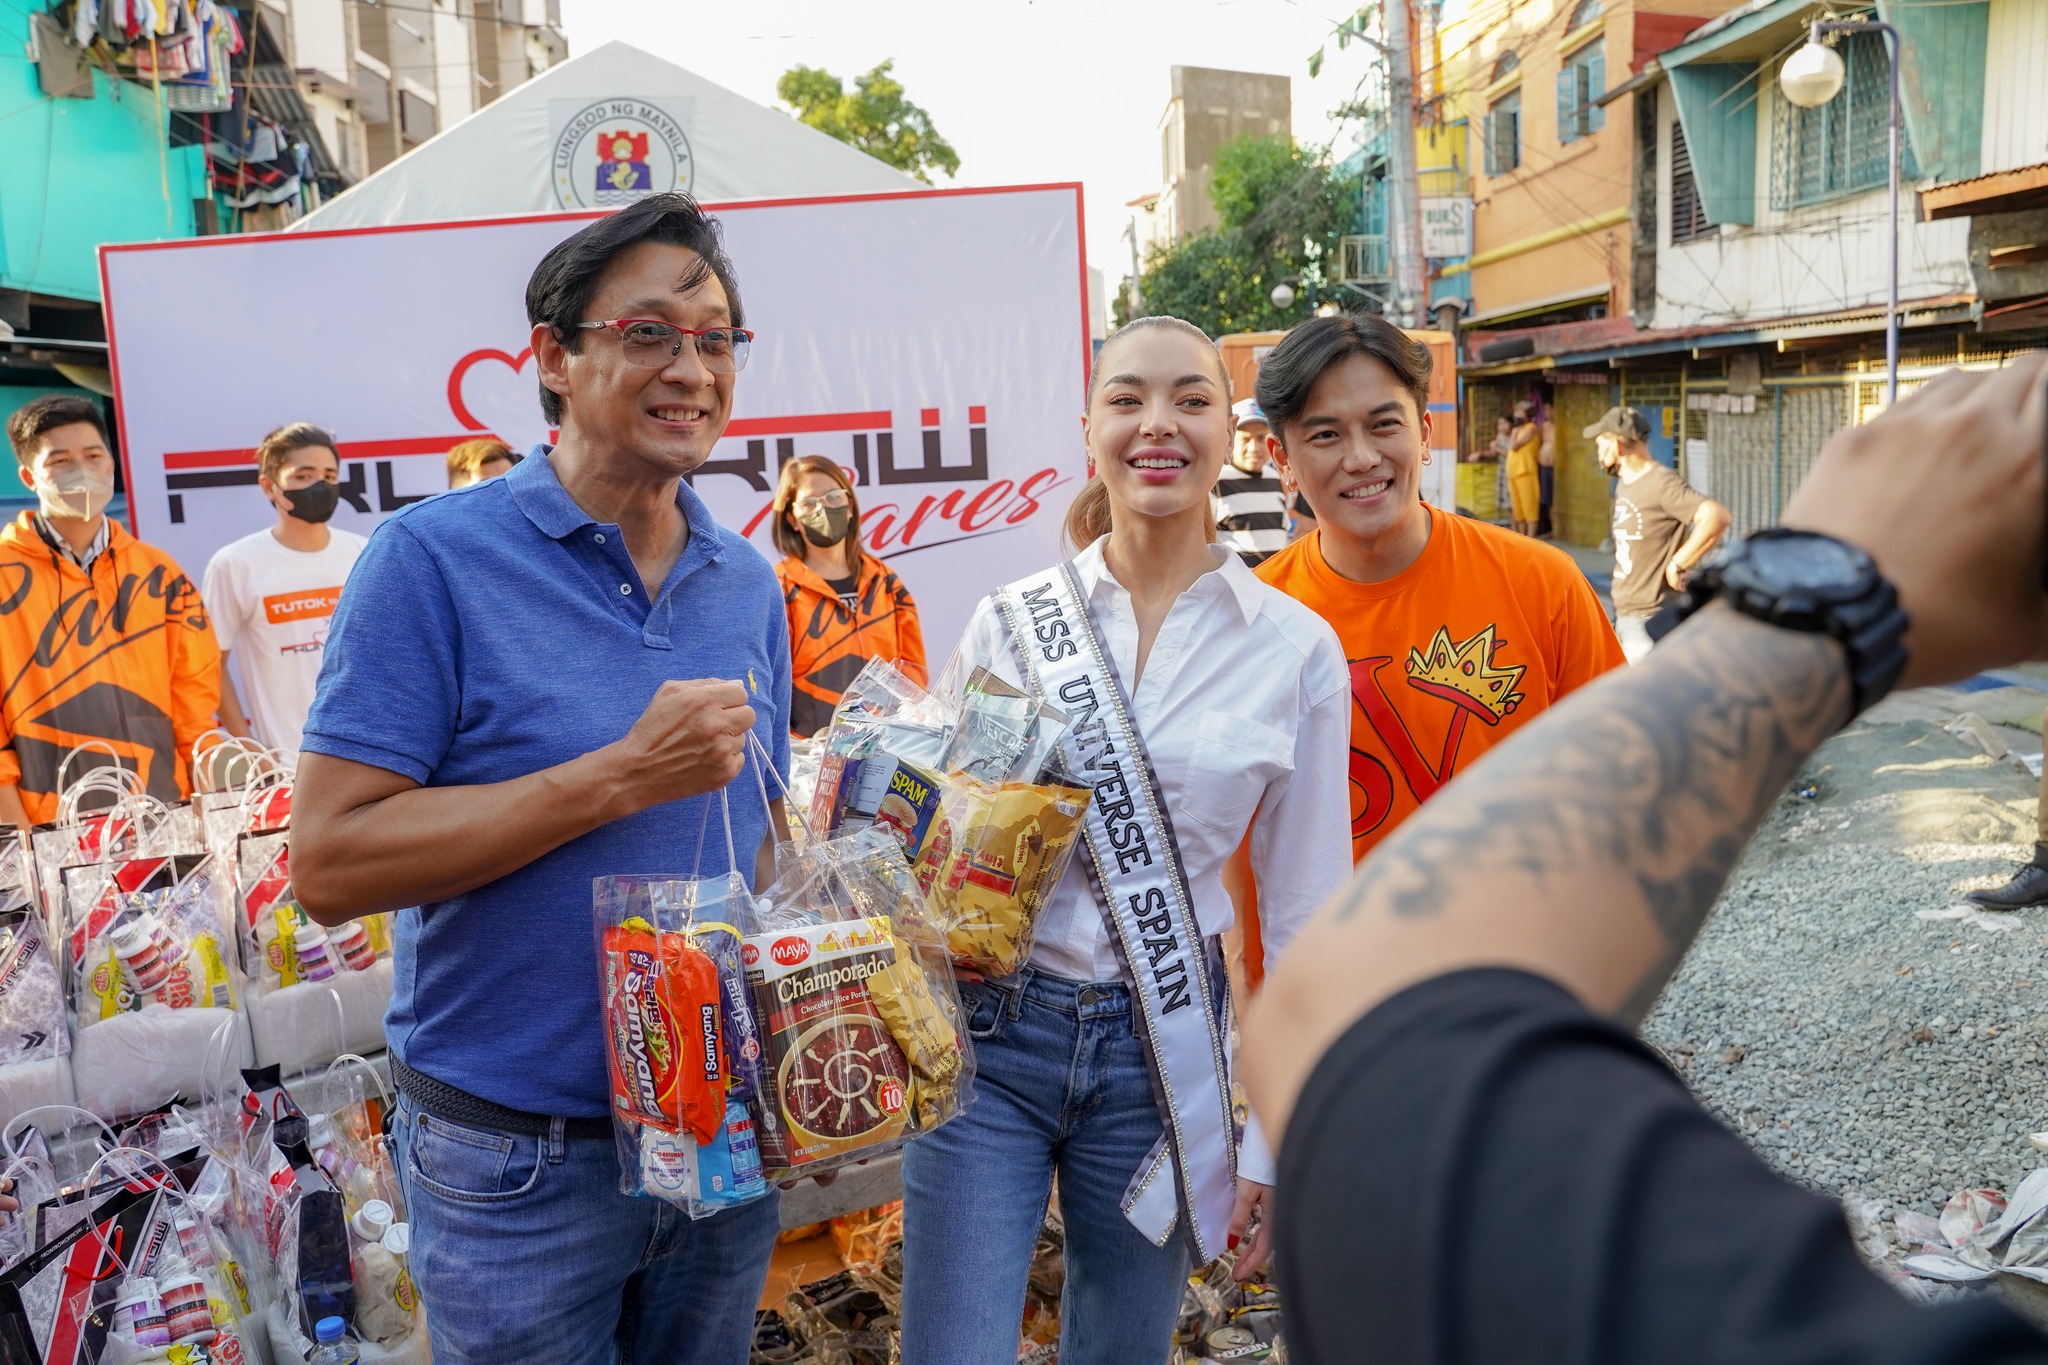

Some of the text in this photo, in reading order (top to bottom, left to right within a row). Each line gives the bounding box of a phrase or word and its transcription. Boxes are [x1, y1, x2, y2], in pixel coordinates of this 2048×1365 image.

[557, 104, 688, 169] LUNGSOD NG MAYNILA
[270, 597, 328, 615] TUTOK
[818, 780, 835, 797] MILK
[820, 767, 842, 783] DAIRY
[890, 769, 929, 807] SPAM
[1021, 582, 1191, 1015] MISS UNIVERSE SPAIN
[772, 942, 809, 961] MAYA
[777, 955, 888, 1003] Champorado
[801, 996, 834, 1015] Chocolate
[835, 992, 851, 1004] Rice
[624, 971, 665, 1120] Samyang
[701, 1006, 718, 1072] Samyang
[883, 1089, 903, 1110] 10
